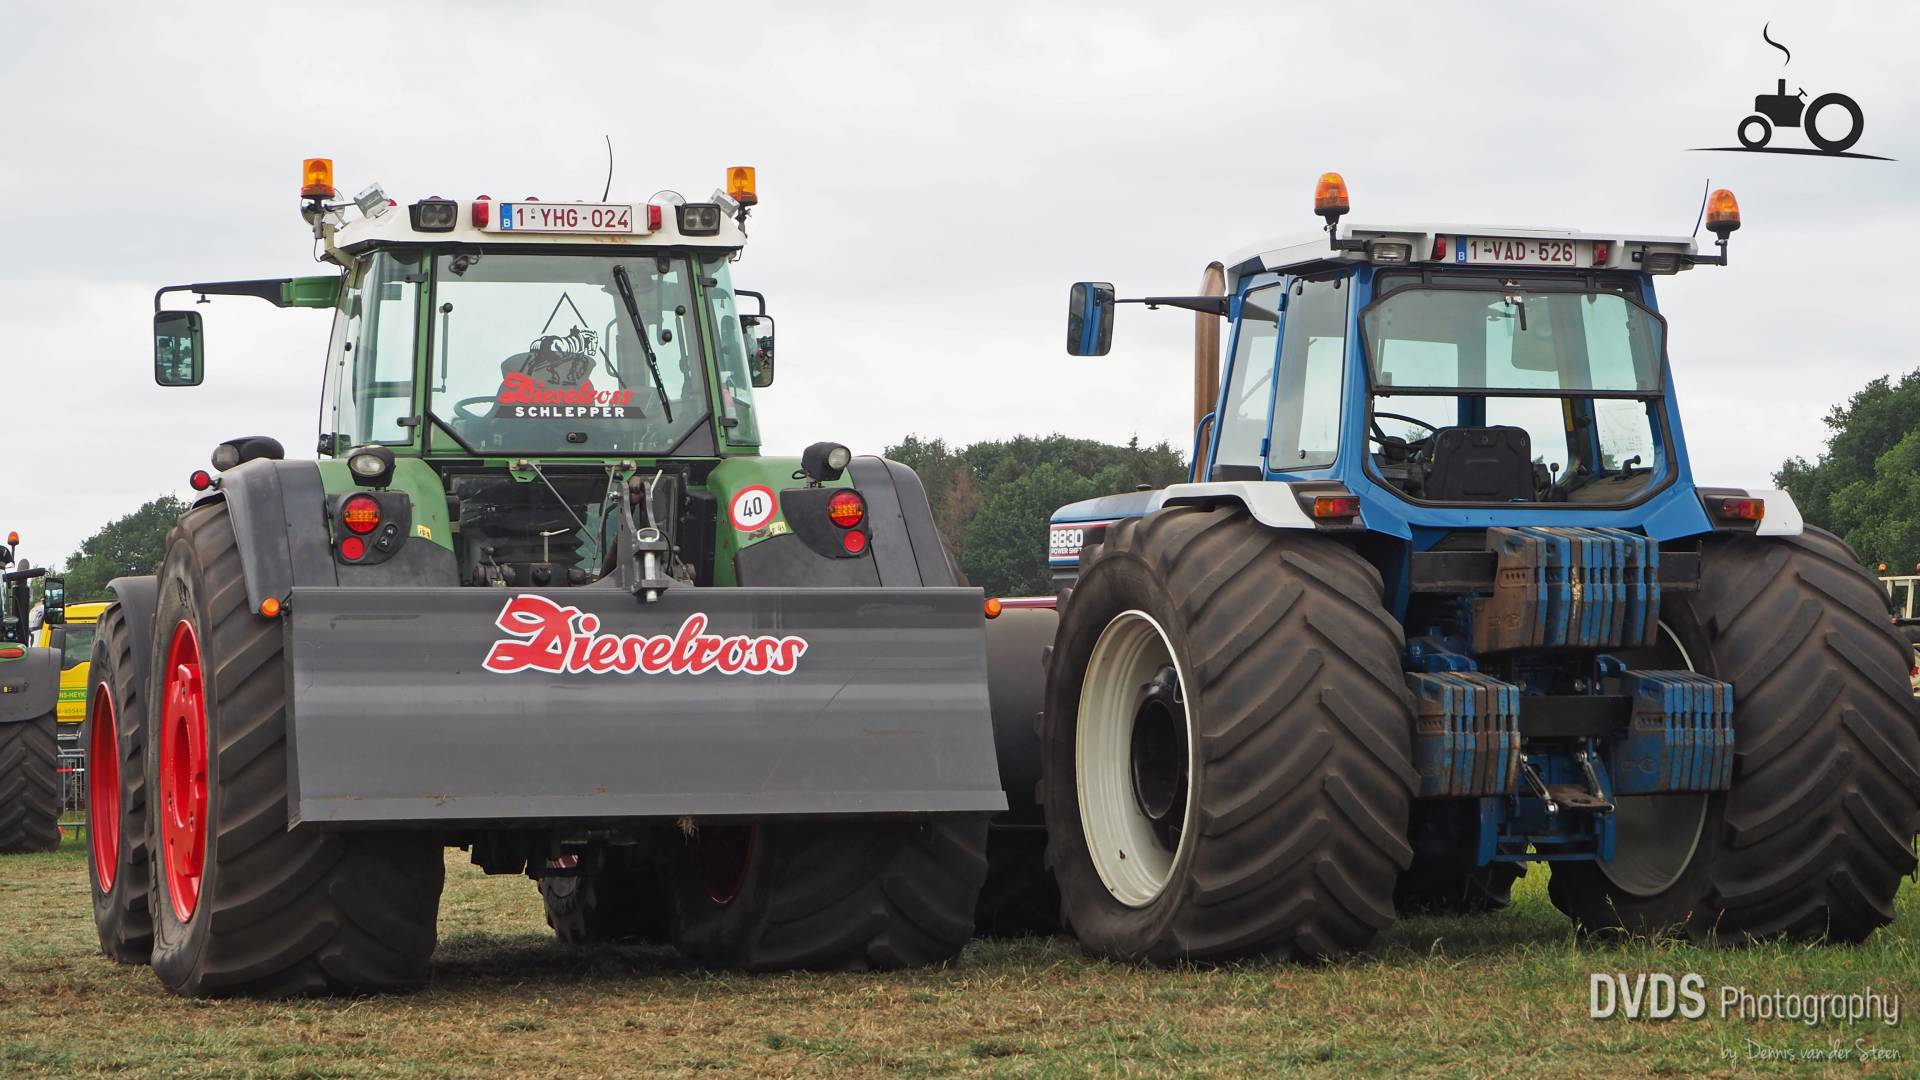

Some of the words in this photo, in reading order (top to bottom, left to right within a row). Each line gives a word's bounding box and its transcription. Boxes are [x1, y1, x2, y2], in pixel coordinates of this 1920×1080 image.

[503, 218, 511, 228] B
[1458, 251, 1466, 262] B
[515, 406, 625, 418] SCHLEPPER
[743, 496, 763, 518] 40
[1050, 529, 1083, 548] 8830
[482, 594, 808, 675] Dieselross
